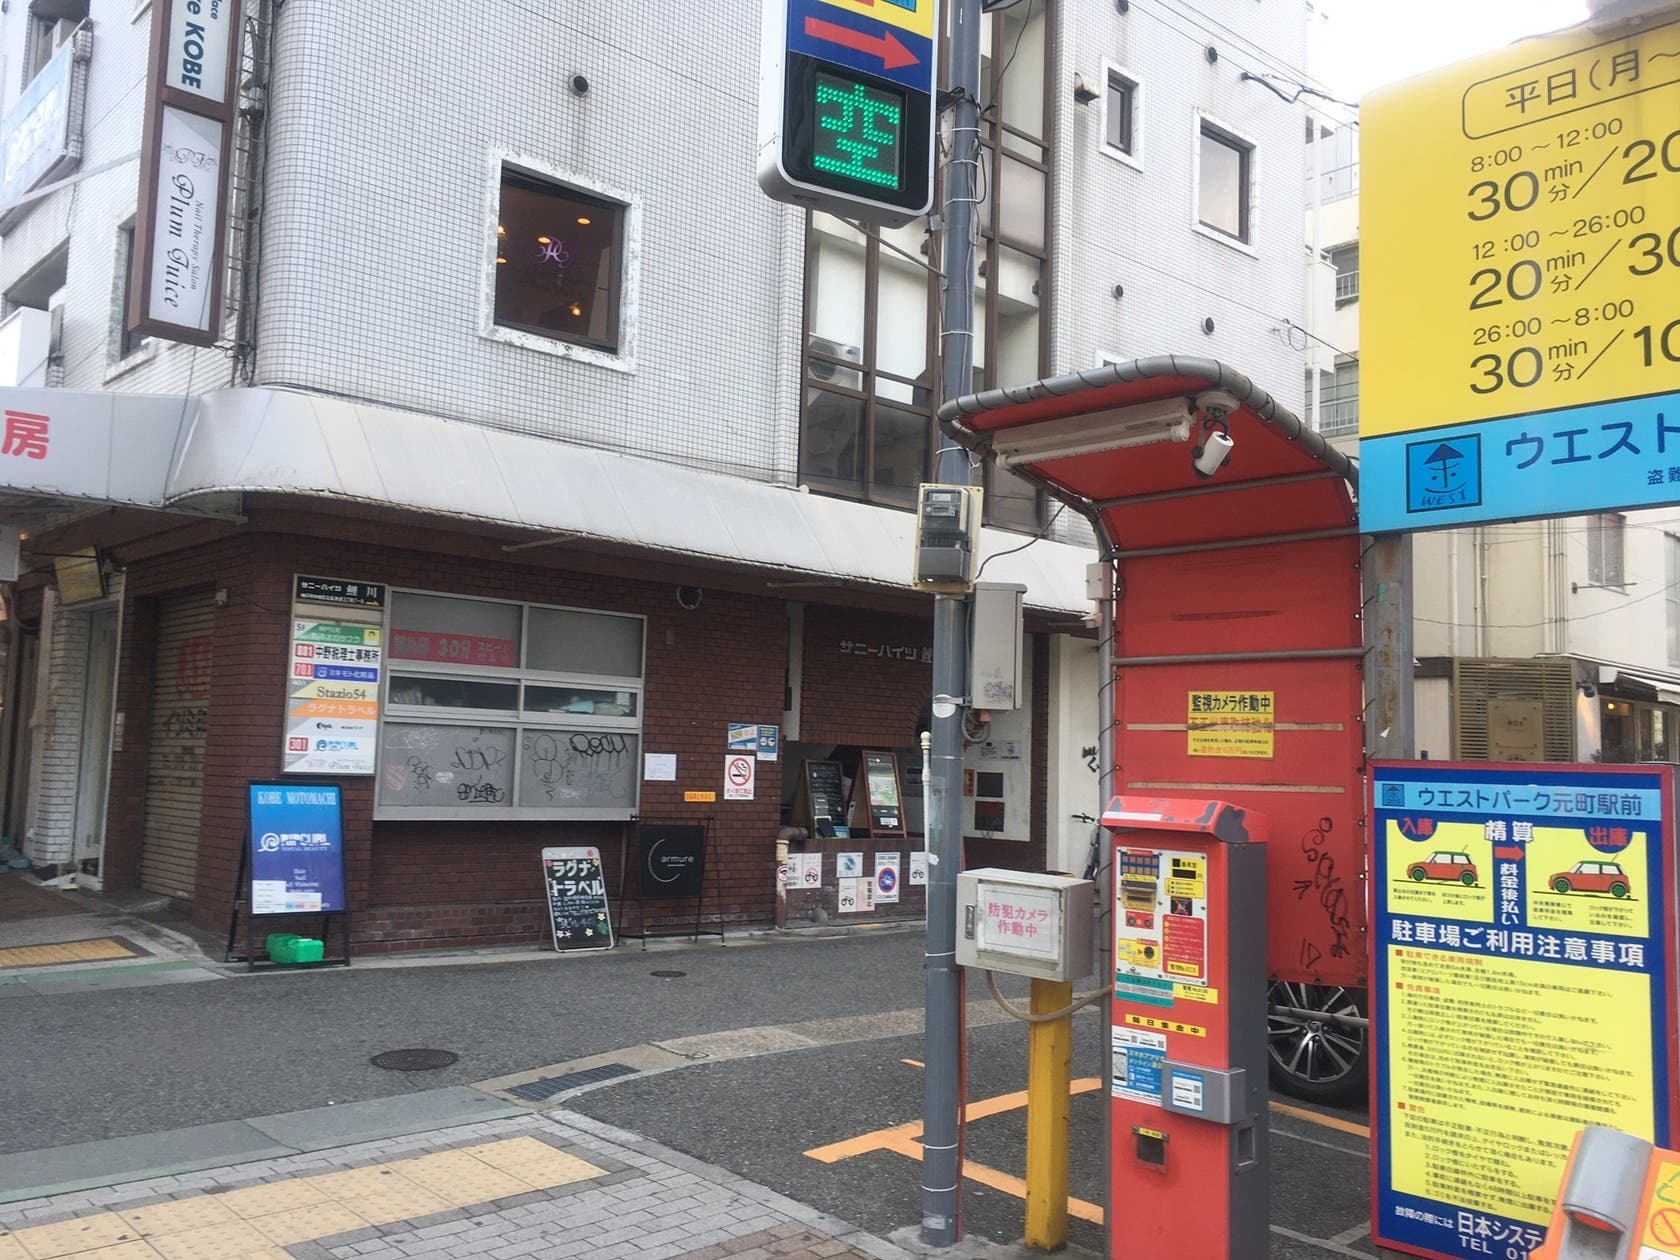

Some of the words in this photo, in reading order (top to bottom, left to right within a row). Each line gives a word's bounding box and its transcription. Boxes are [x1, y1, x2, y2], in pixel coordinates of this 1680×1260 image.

[181, 21, 205, 89] KOBE
[815, 83, 900, 188] 空
[169, 174, 195, 238] Plum
[2, 410, 50, 460] 房
[1192, 694, 1271, 712] 監視カメラ作動中
[1418, 788, 1642, 816] ウエストパーク元町駅前
[1401, 817, 1433, 835] 入庫
[1484, 820, 1534, 842] 精算
[1589, 826, 1629, 847] 出庫
[1500, 863, 1520, 925] 料金後払い
[988, 902, 1048, 921] 防犯カメラ
[998, 920, 1037, 938] 作動中
[1391, 919, 1645, 968] 駐車場ご利用注意事項
[1394, 1205, 1455, 1229] 故障の際には
[1458, 1235, 1494, 1254] TEL
